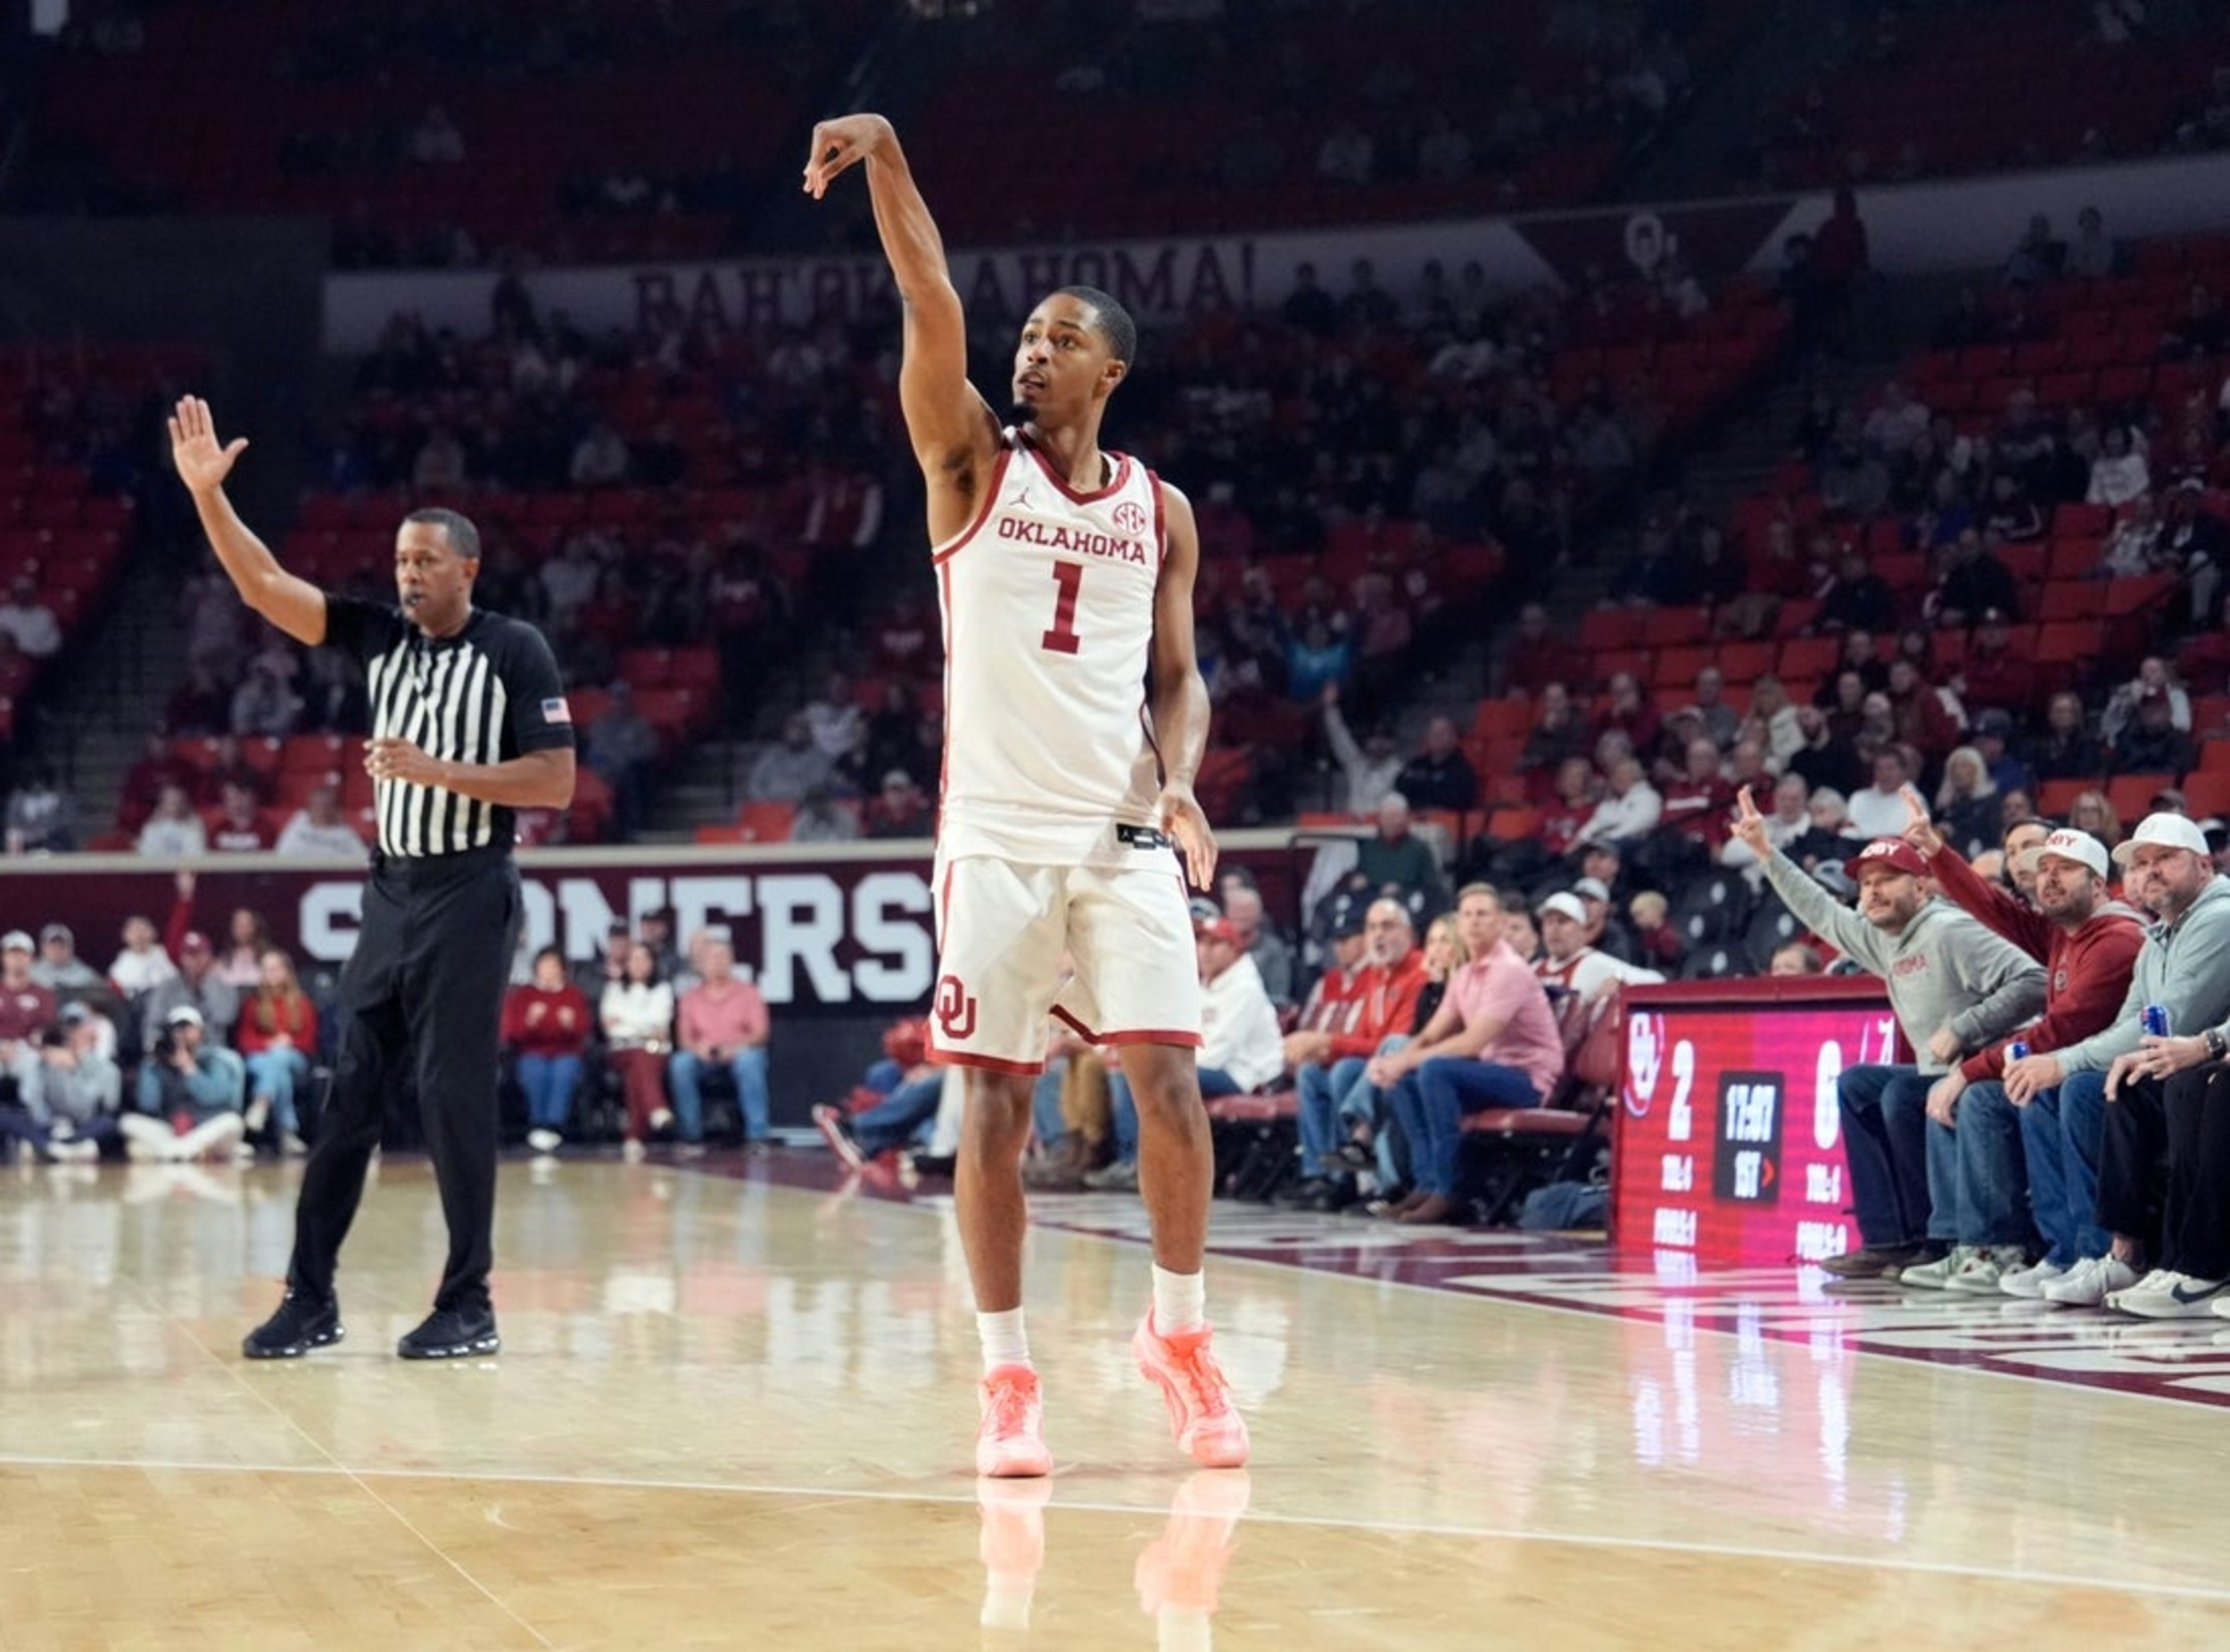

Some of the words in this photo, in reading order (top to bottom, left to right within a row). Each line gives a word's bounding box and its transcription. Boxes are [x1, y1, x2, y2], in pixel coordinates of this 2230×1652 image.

[997, 516, 1145, 565] OKLAHOMA
[1112, 502, 1147, 535] SEC
[1041, 560, 1084, 655] 1
[300, 872, 934, 1004] SNERS
[934, 974, 977, 1040] OU
[1667, 1039, 1695, 1142] 2
